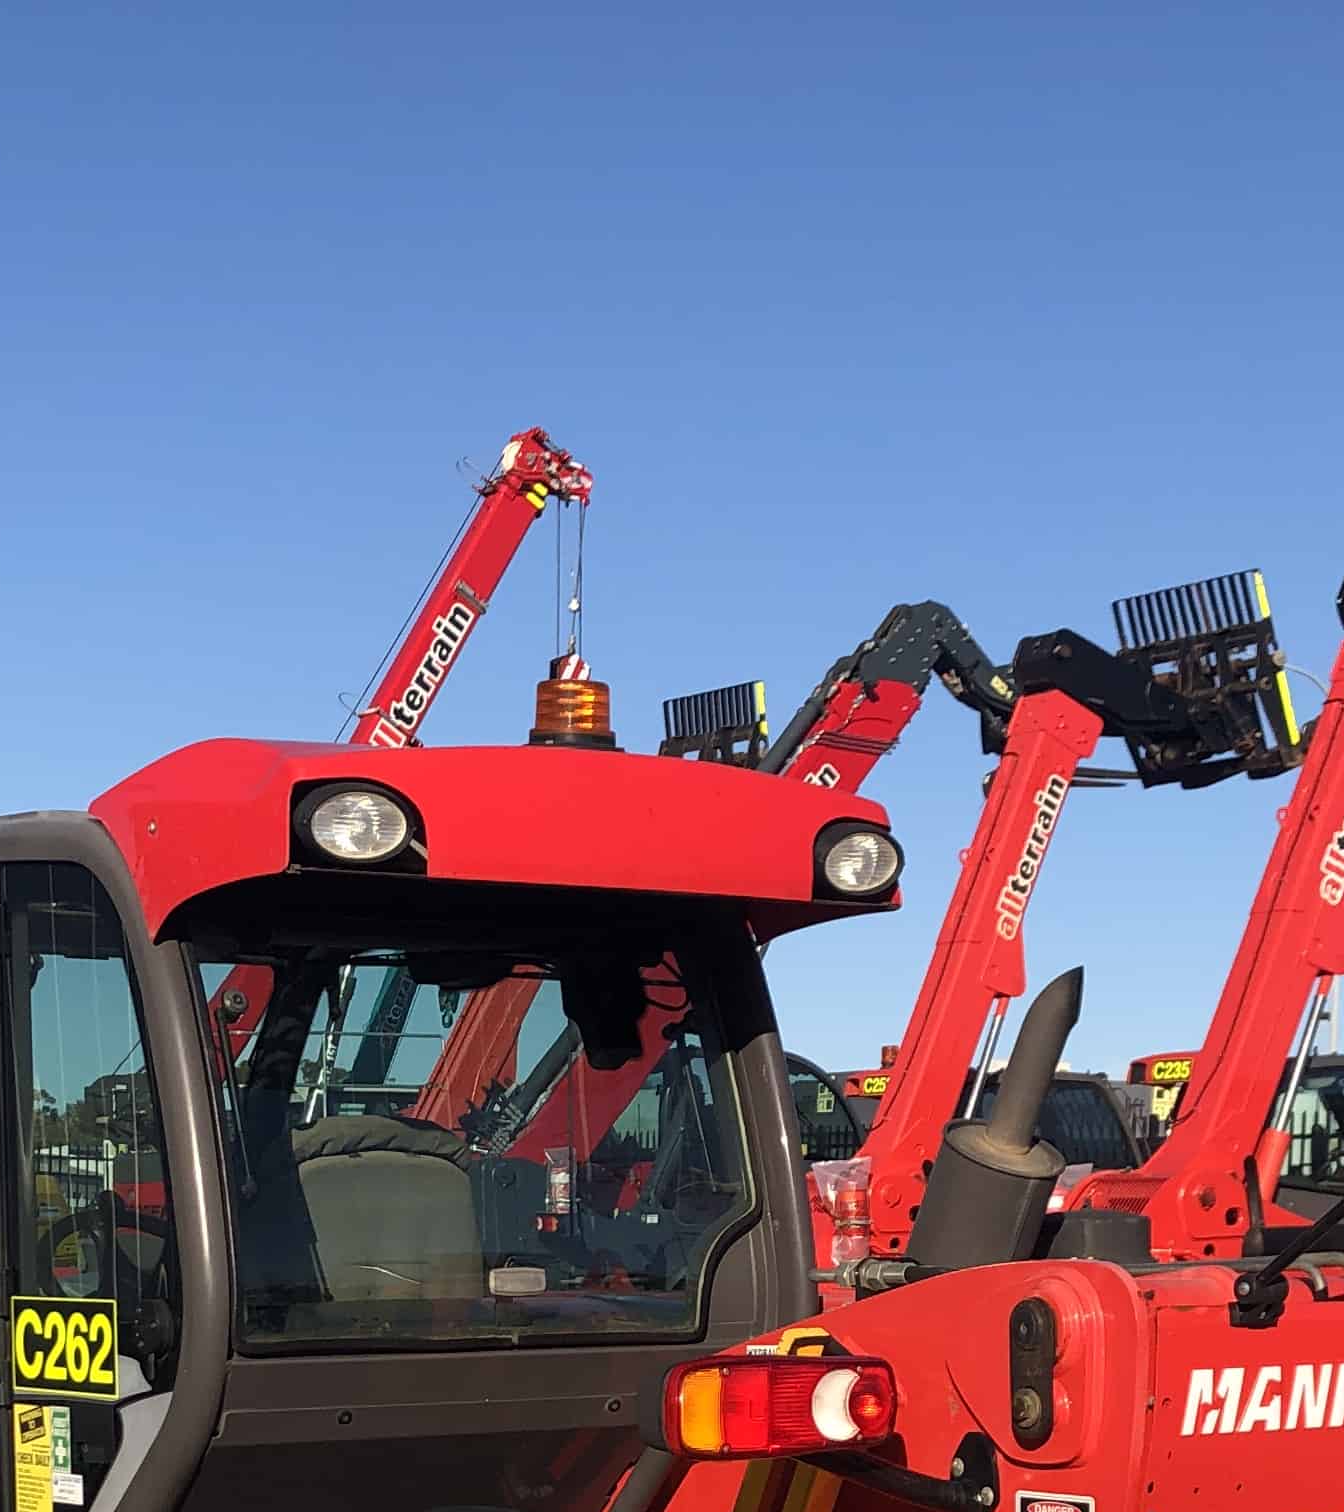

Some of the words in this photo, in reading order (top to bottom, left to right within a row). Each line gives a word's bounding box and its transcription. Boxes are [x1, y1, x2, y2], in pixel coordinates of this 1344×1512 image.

[369, 603, 475, 748] llterrain
[996, 774, 1070, 941] allterrain
[1153, 1060, 1192, 1080] C235
[15, 1309, 113, 1384] C262
